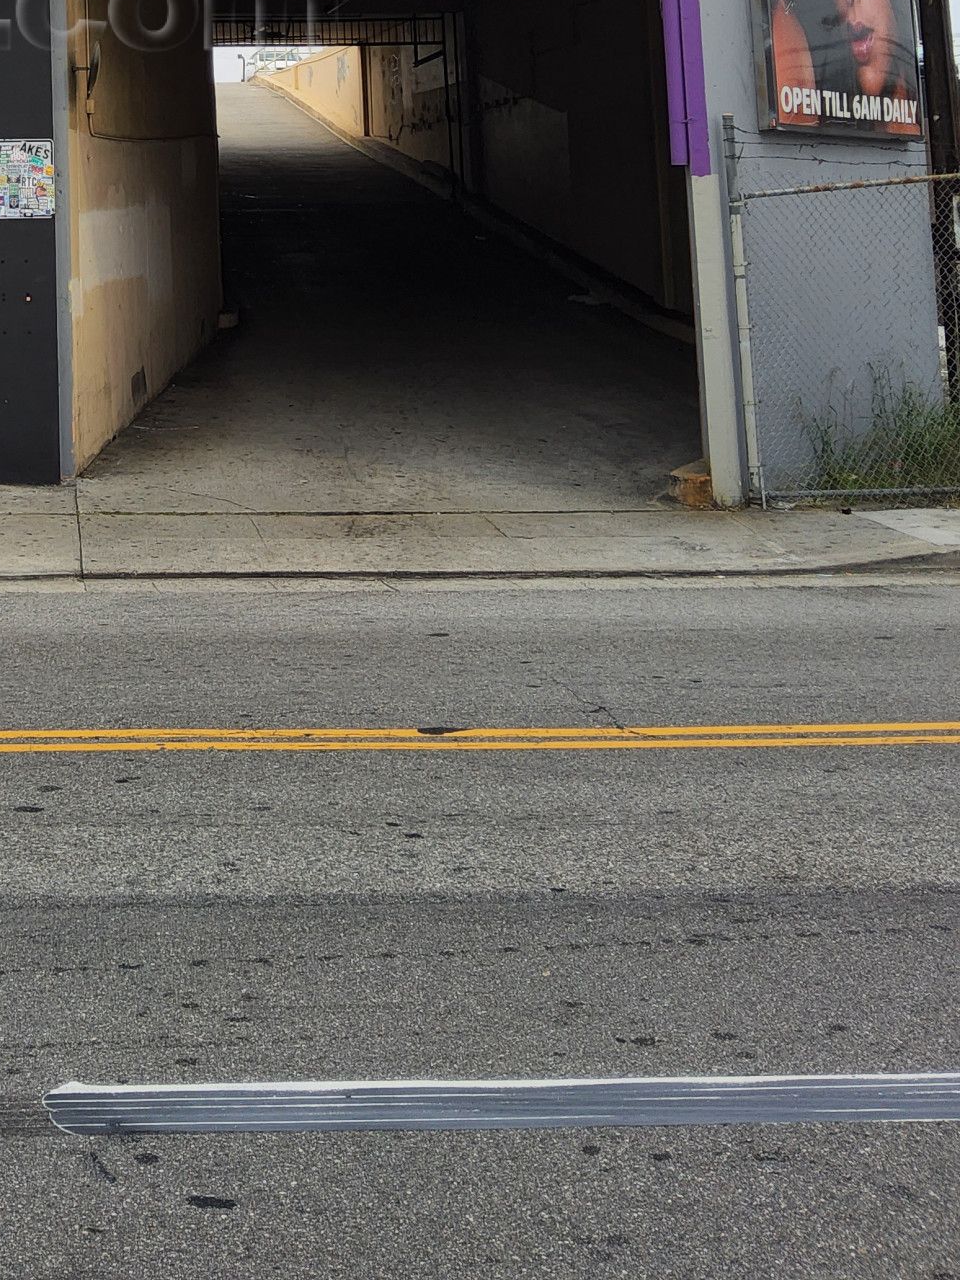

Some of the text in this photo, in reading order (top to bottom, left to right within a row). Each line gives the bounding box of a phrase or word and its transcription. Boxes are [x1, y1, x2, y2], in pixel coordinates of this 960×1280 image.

[780, 85, 918, 124] OPEN TILL 6AM DAILY
